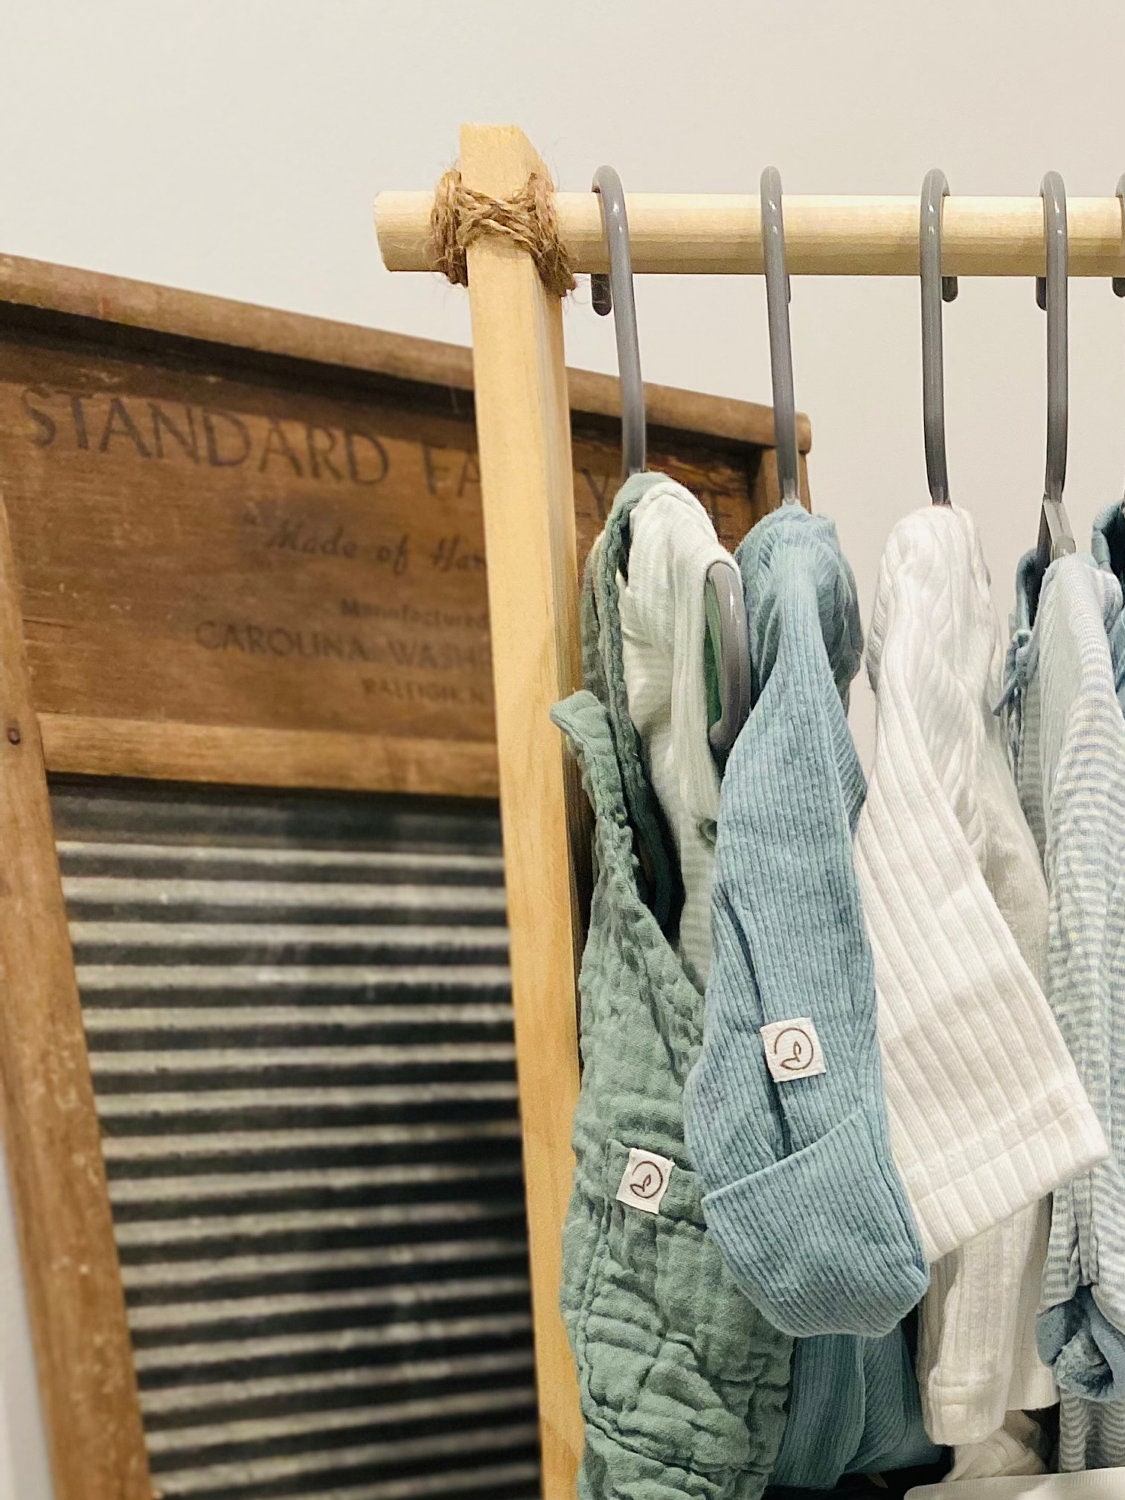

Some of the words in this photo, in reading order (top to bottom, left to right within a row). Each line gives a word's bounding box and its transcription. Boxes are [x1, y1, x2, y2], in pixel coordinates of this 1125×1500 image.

[21, 387, 390, 486] STANDARD
[375, 533, 411, 577] of
[194, 619, 369, 662] CAROLINA
